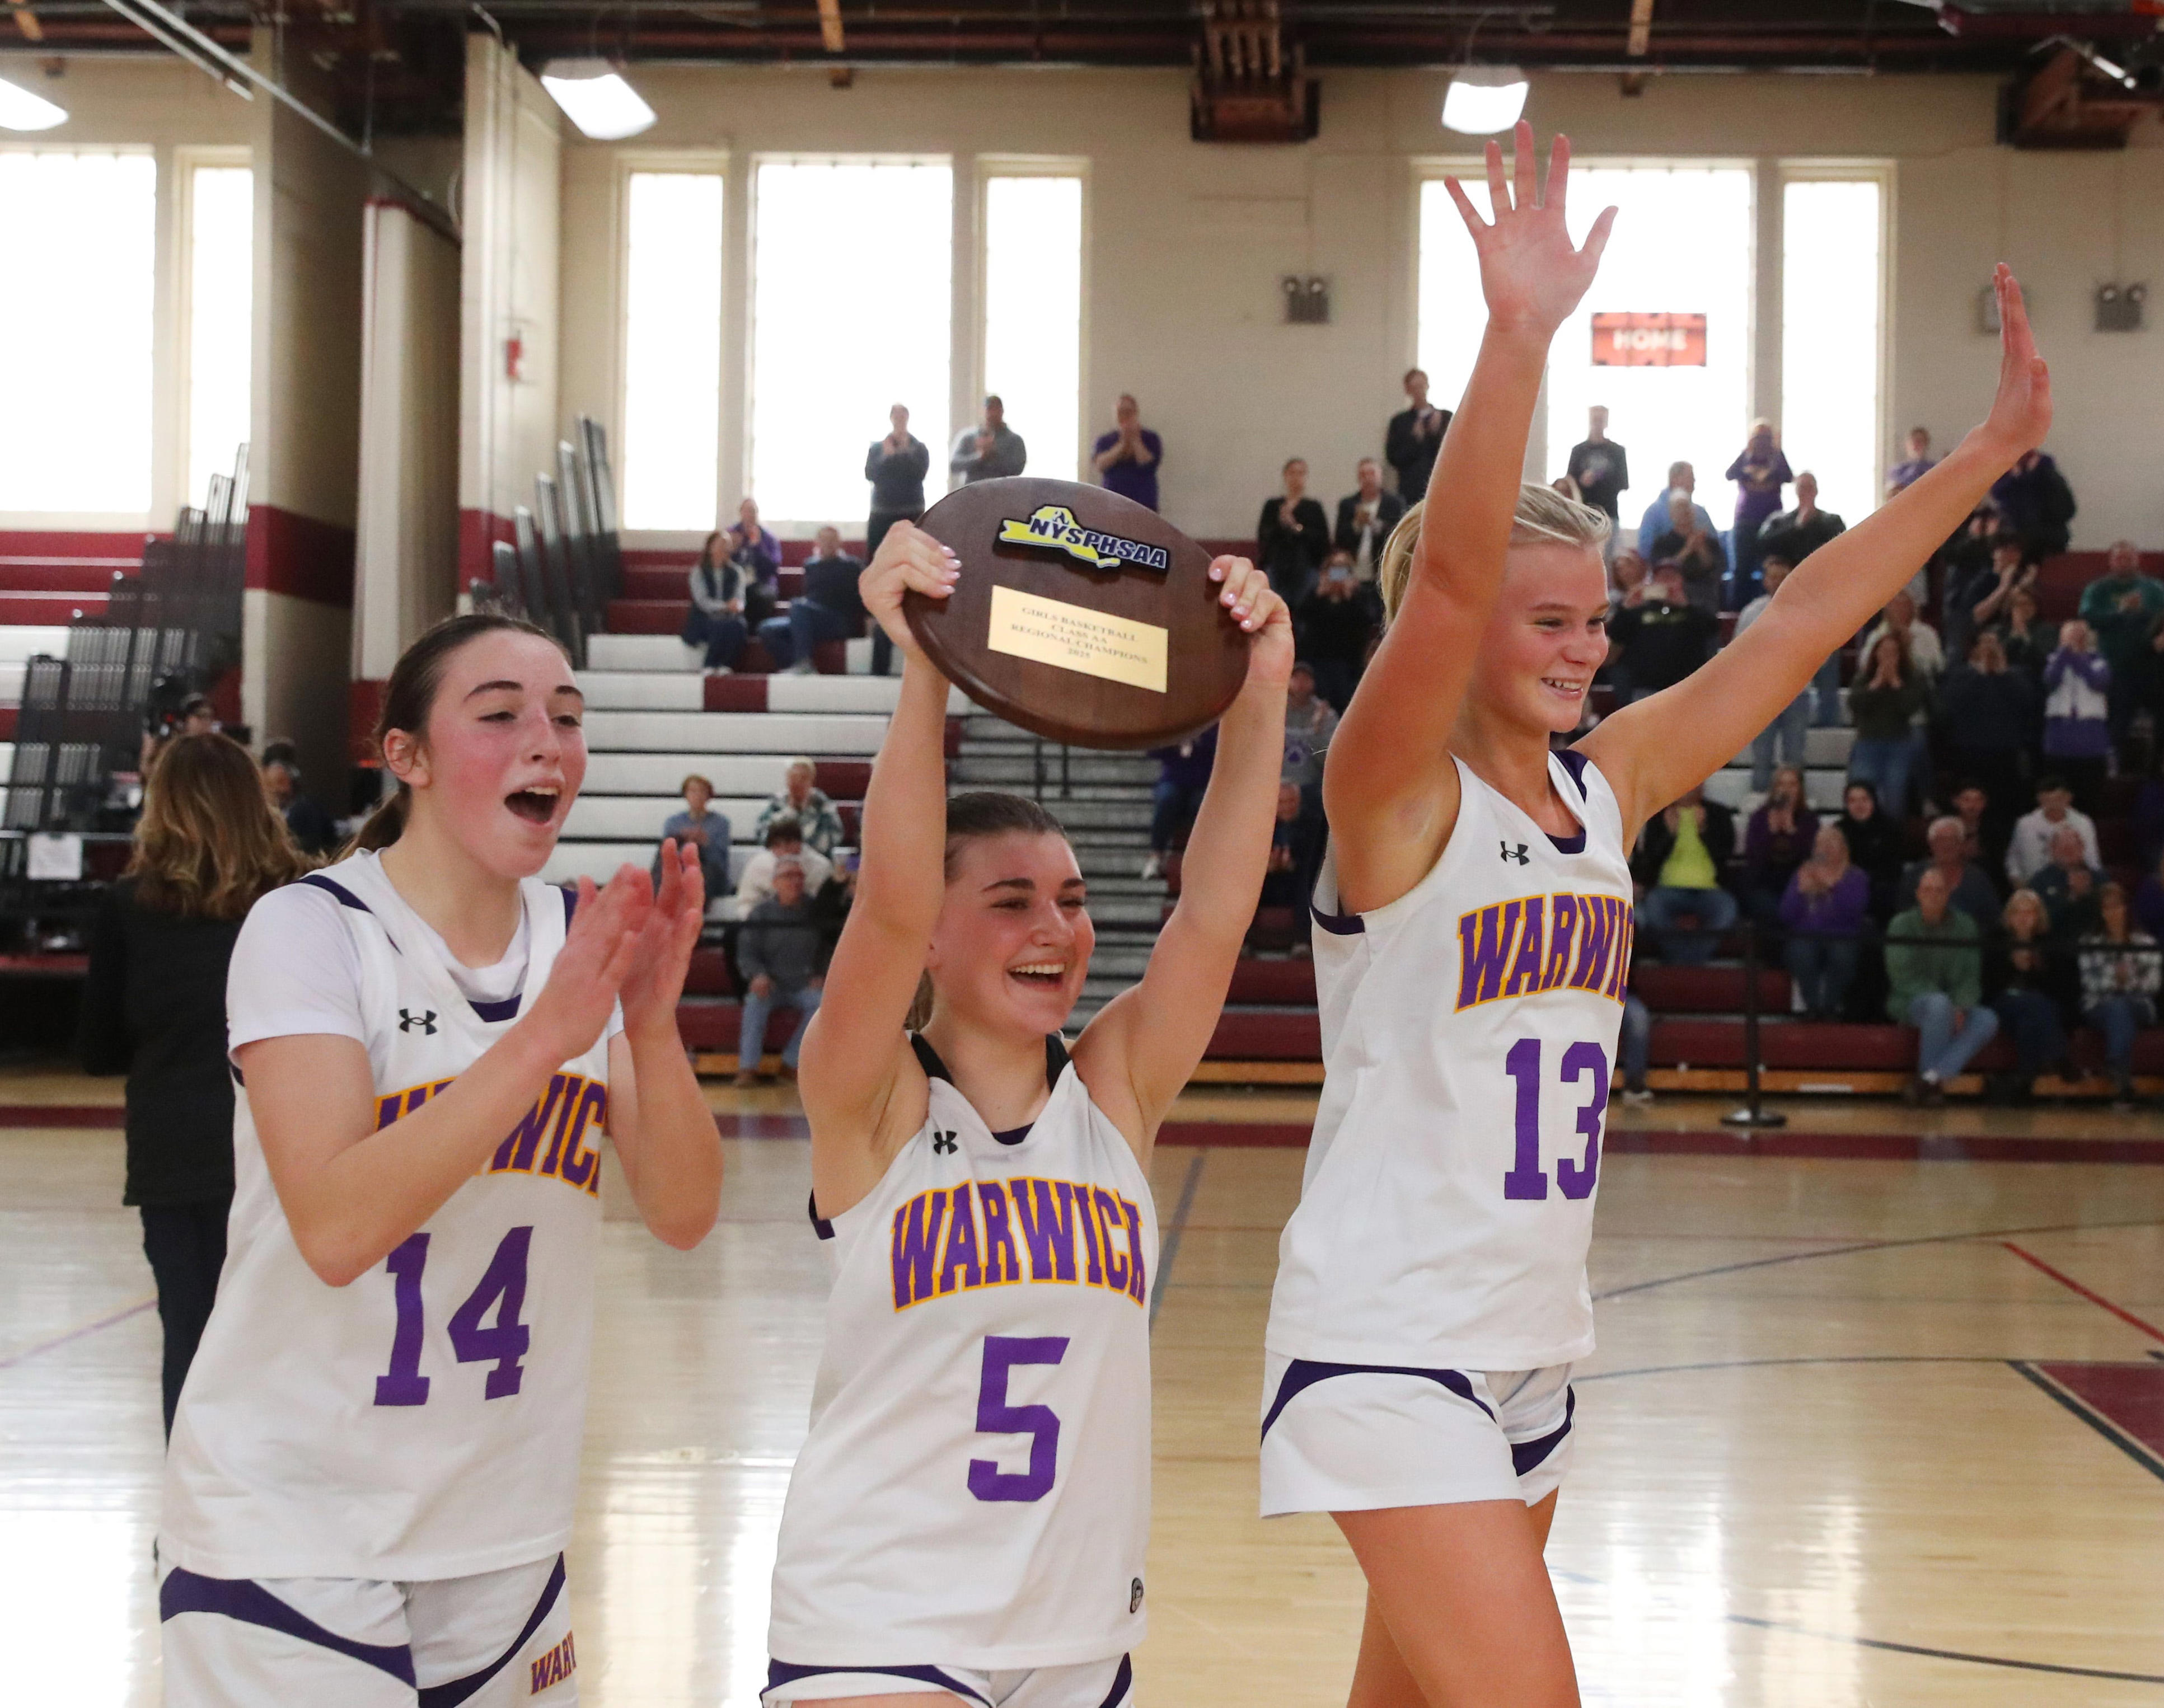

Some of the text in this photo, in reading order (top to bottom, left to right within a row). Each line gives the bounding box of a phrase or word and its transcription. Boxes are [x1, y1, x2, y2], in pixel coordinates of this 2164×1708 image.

[1030, 518, 1167, 569] NYSPHSAA
[1010, 623, 1148, 664] REGIONAL CHAMPIONS
[1022, 607, 1136, 642] GIRLS BASKETBALL
[1051, 623, 1108, 644] CLASS AA
[1455, 891, 1634, 1013] WARWIC
[1505, 1039, 1608, 1200] 13
[373, 1226, 534, 1406] 14
[967, 1335, 1070, 1502] 5
[530, 1630, 577, 1696] WAR
